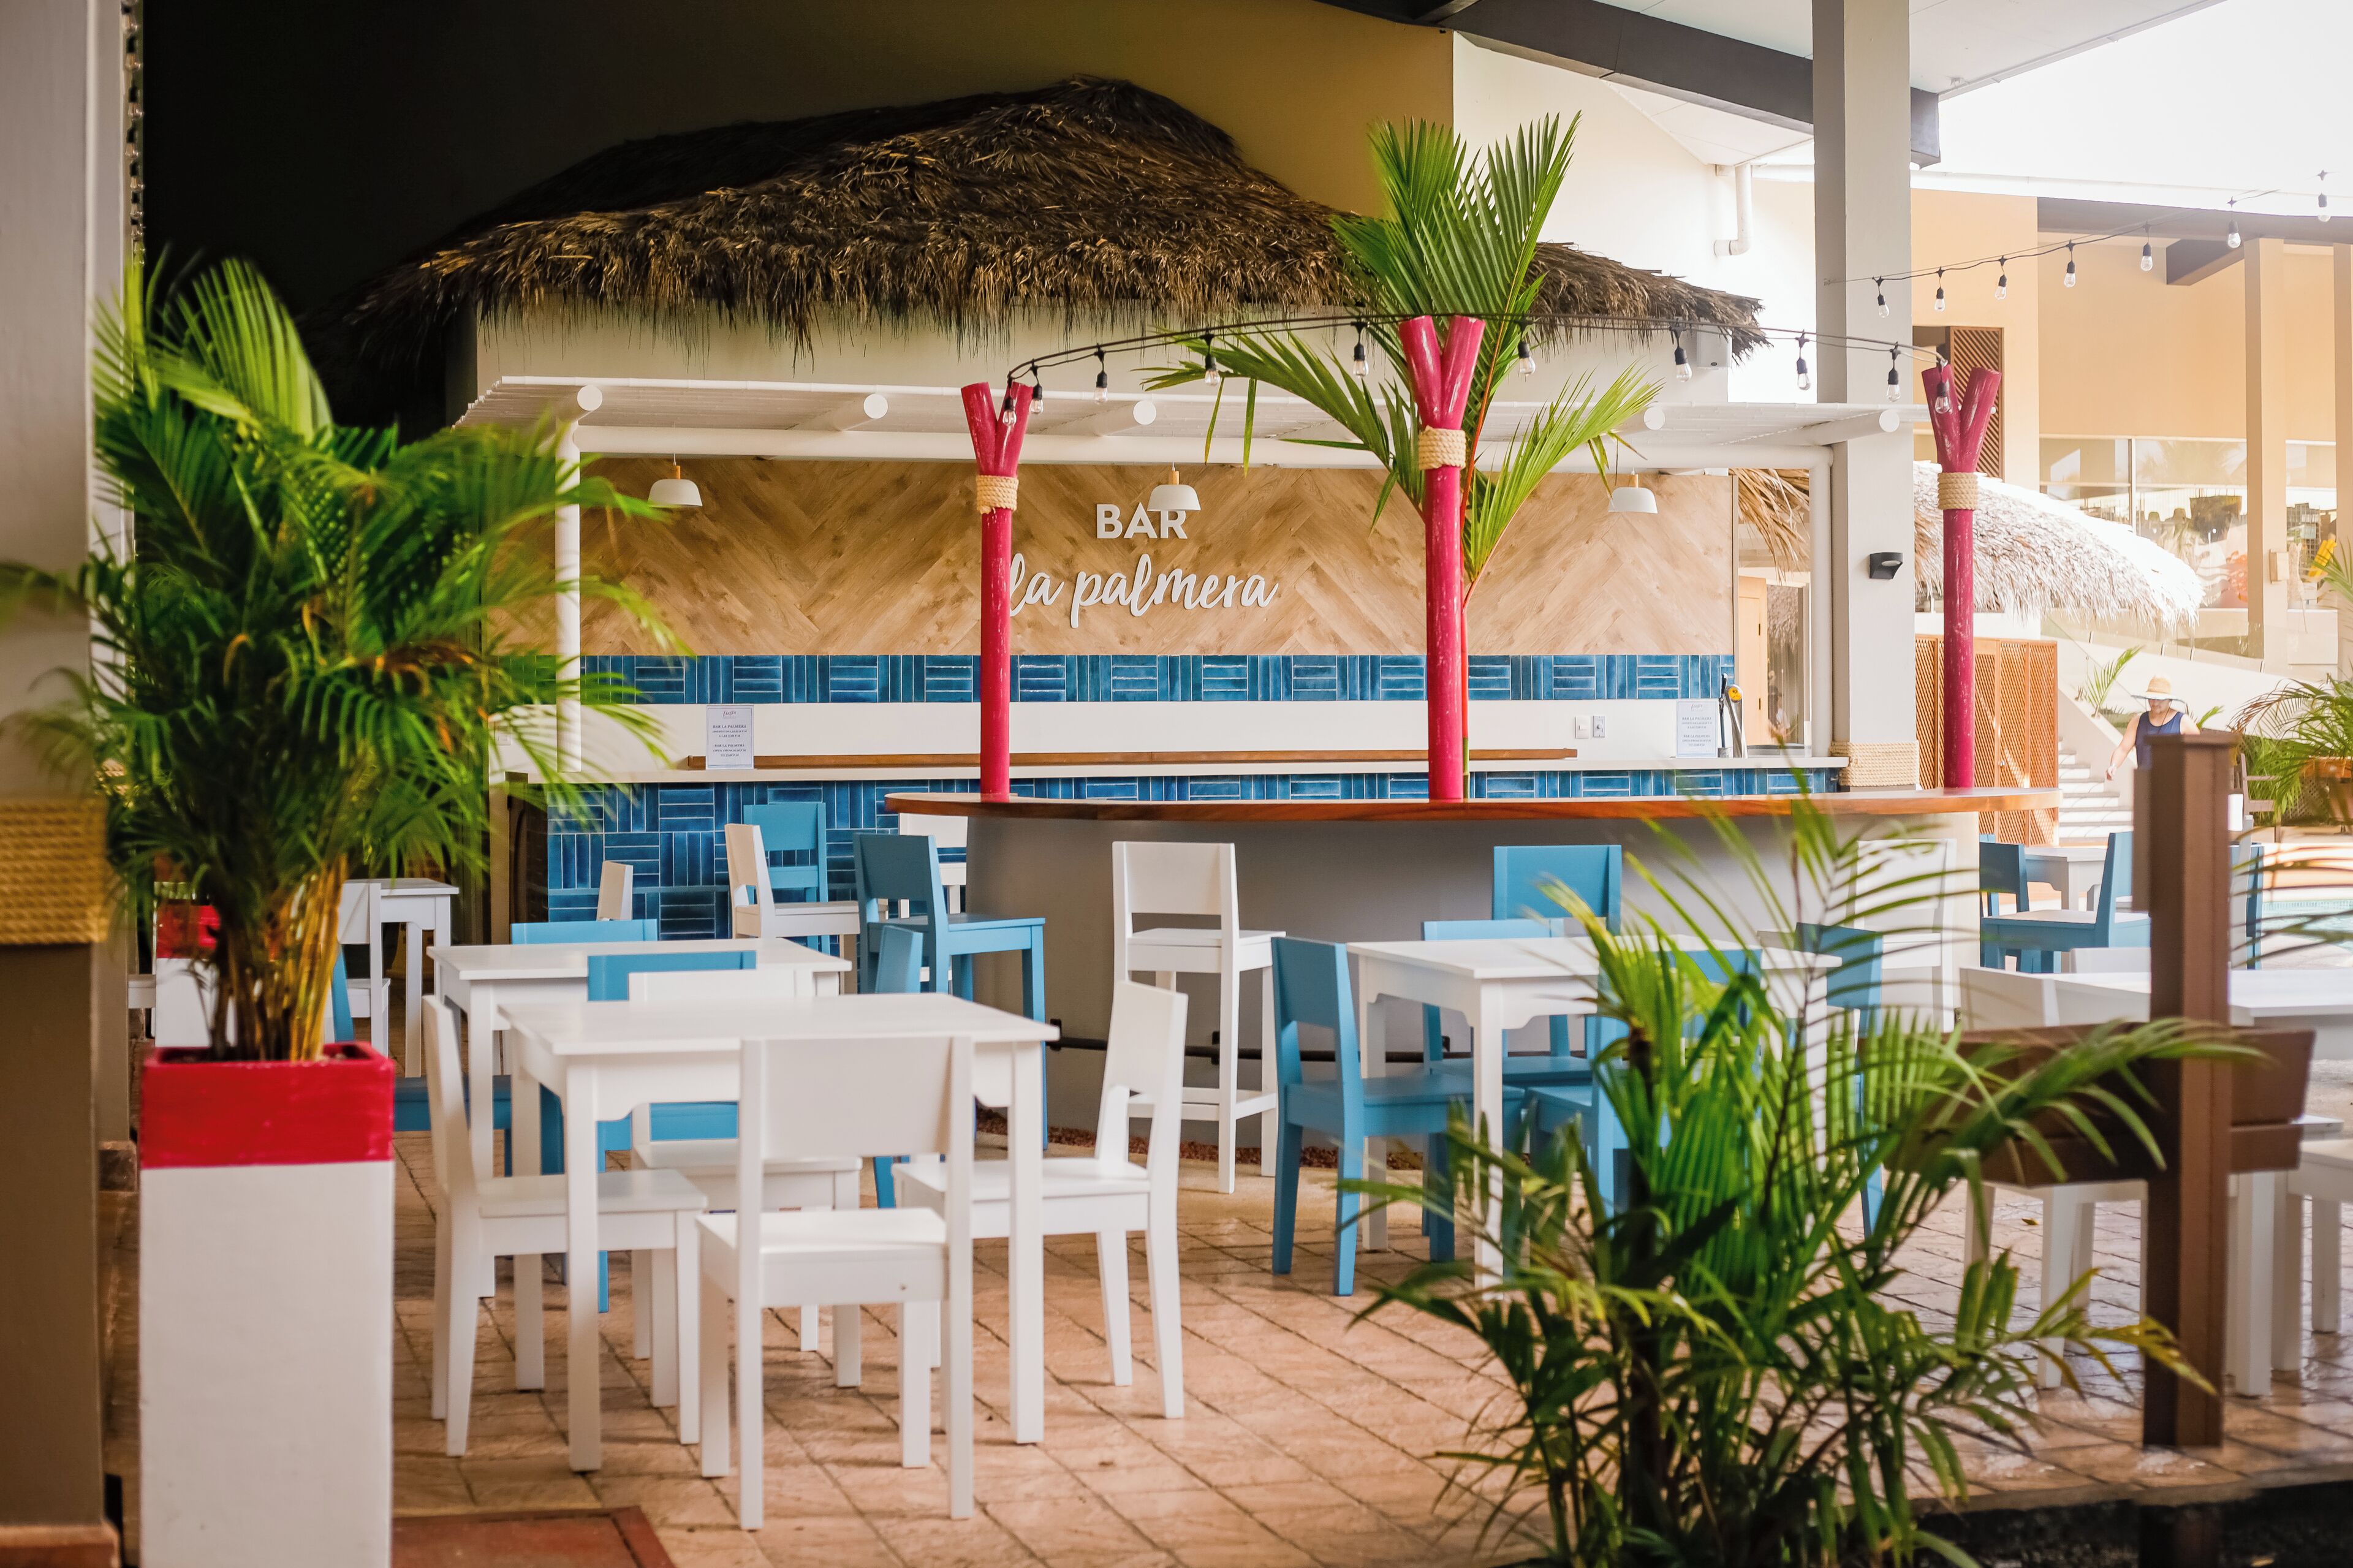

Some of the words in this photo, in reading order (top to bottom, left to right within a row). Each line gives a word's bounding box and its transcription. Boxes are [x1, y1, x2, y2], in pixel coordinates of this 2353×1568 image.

[1096, 502, 1188, 539] BAR
[1010, 553, 1065, 617] la
[1070, 553, 1279, 629] palmera
